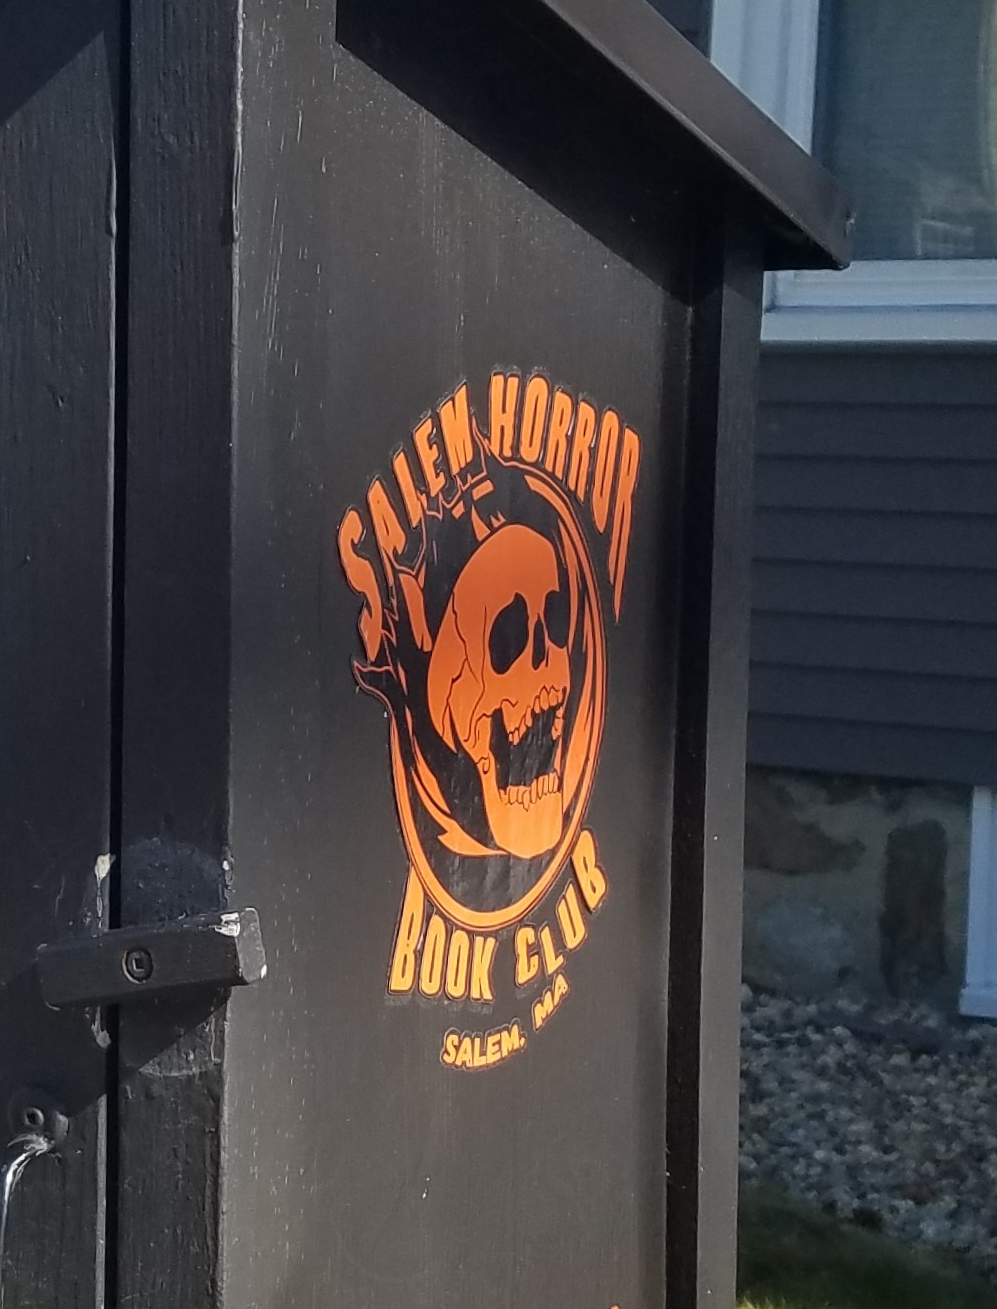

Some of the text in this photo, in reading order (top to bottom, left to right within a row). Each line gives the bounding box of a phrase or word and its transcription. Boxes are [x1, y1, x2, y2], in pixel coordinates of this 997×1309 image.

[337, 372, 642, 663] SALEM HORROR
[388, 827, 608, 1002] BOOK CLUB
[531, 973, 570, 1030] MA
